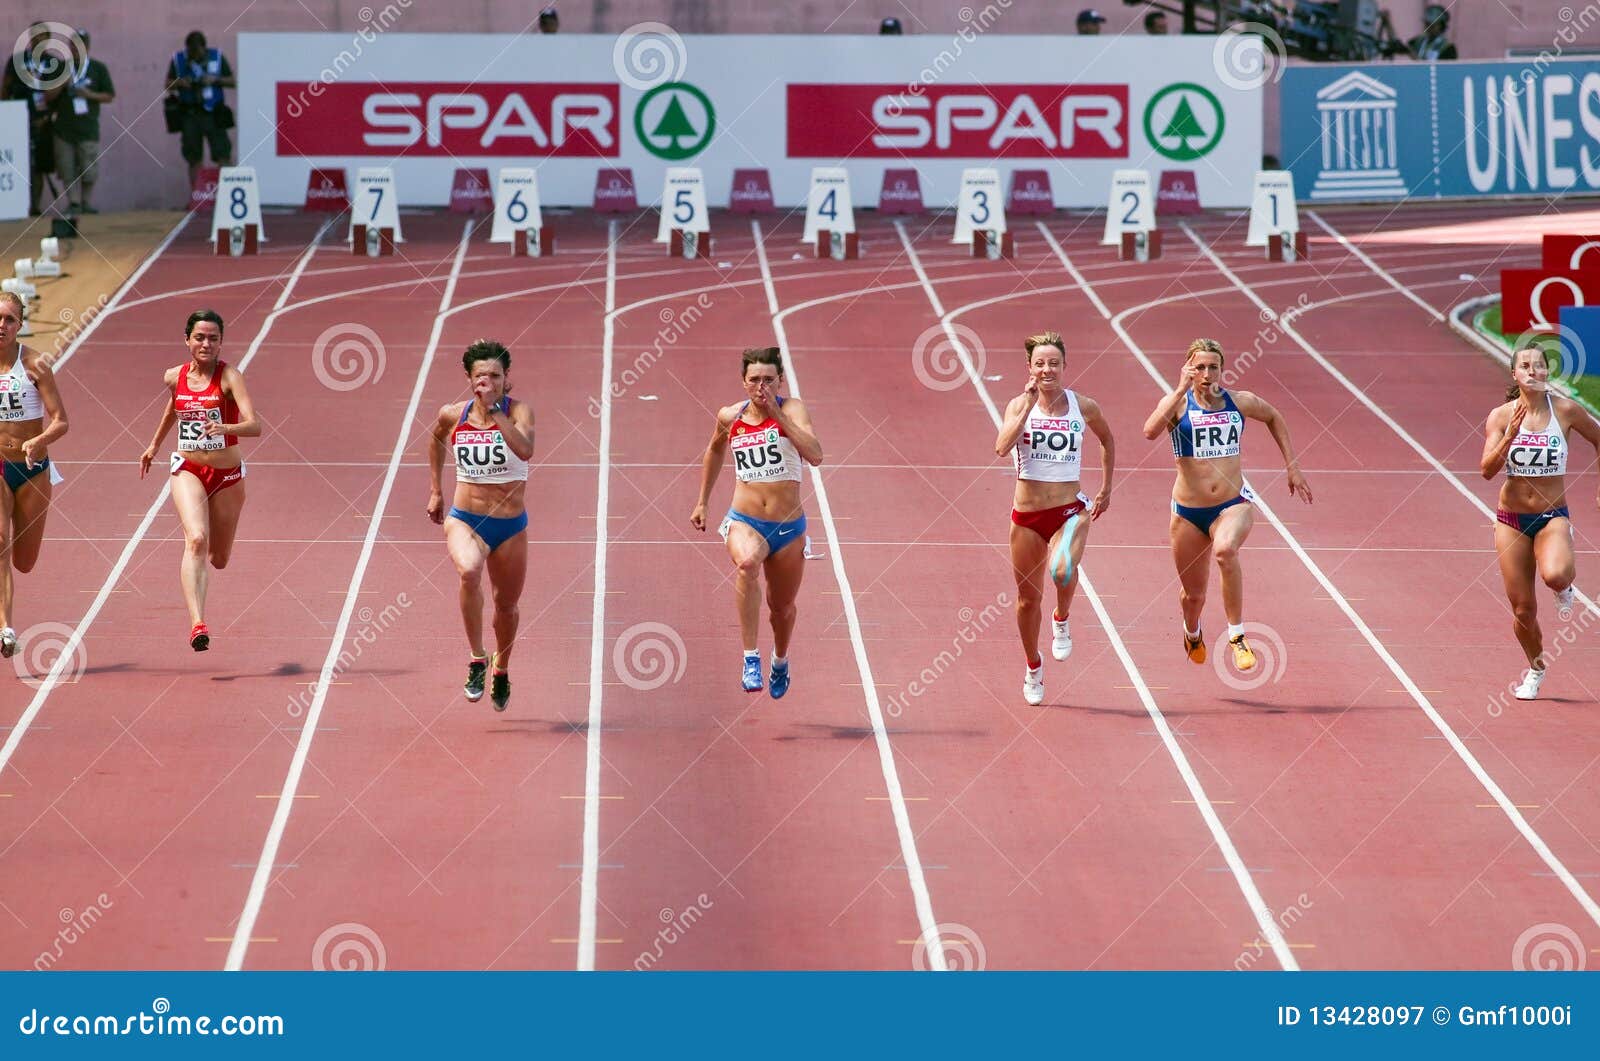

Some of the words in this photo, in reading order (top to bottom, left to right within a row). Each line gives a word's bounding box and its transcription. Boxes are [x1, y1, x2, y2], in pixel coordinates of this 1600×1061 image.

[362, 93, 613, 147] SPAR
[872, 93, 1122, 149] SPAR
[230, 187, 248, 219] 8
[368, 188, 384, 220] 7
[507, 190, 528, 222] 6
[673, 190, 695, 223] 5
[818, 189, 838, 221] 4
[970, 190, 990, 224] 3
[1121, 192, 1140, 224] 2
[1270, 194, 1278, 226] 1
[180, 421, 213, 440] ES
[1032, 419, 1070, 430] SPAR
[1193, 414, 1229, 426] SPAR
[457, 432, 493, 443] SPAR
[733, 432, 766, 447] SPAR
[1031, 431, 1078, 452] POL
[1194, 425, 1239, 448] FRA
[457, 446, 506, 466] RUS
[734, 444, 783, 471] RUS
[1196, 449, 1223, 458] LEIRIA
[1510, 447, 1559, 467] CZE
[487, 467, 508, 475] 2009
[765, 466, 785, 477] 2009
